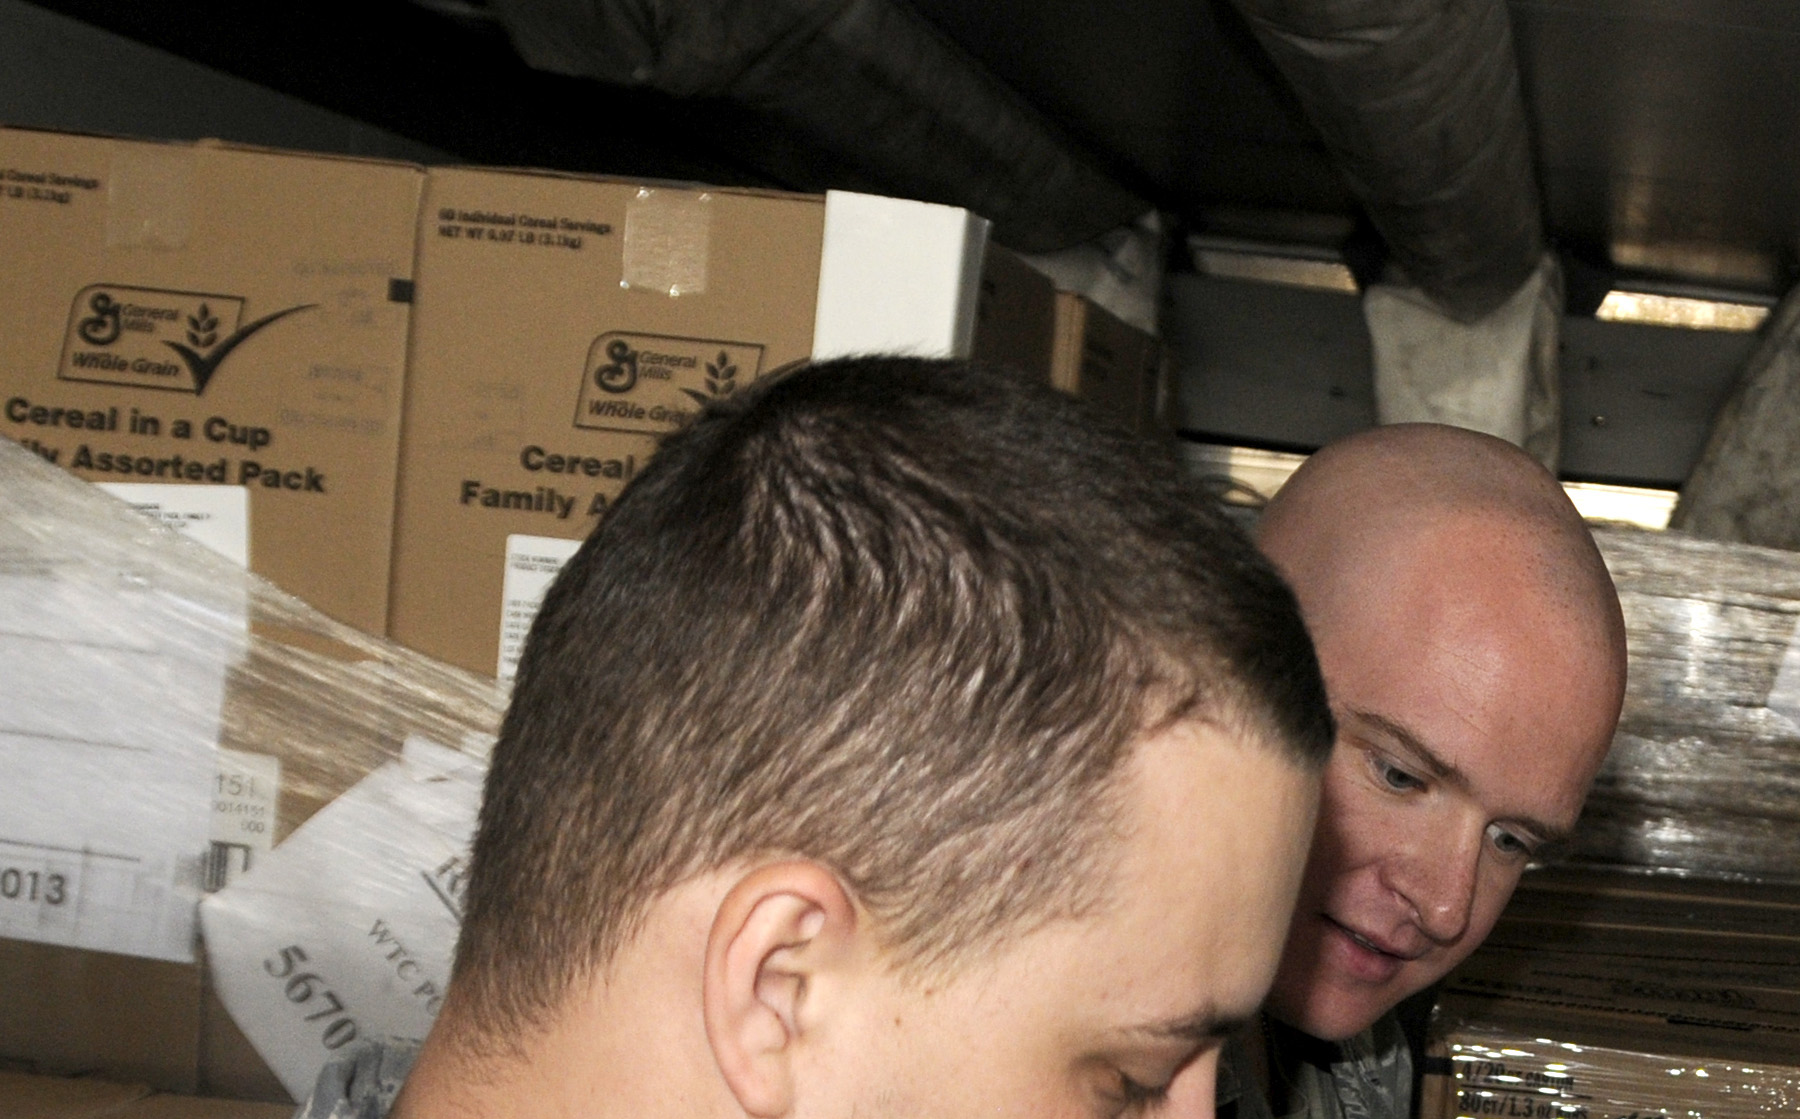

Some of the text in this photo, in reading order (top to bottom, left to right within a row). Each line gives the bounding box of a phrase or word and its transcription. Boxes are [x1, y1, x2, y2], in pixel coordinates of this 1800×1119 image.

[72, 351, 179, 377] Whole Grain
[638, 350, 697, 368] General
[5, 398, 271, 450] Cereal in a Cup
[588, 400, 645, 419] Whole
[71, 443, 228, 483] Assorted
[239, 460, 325, 492] Pack
[520, 445, 634, 480] Cereal
[460, 480, 576, 519] Family
[367, 918, 421, 983] WTC
[263, 944, 360, 1052] 5670
